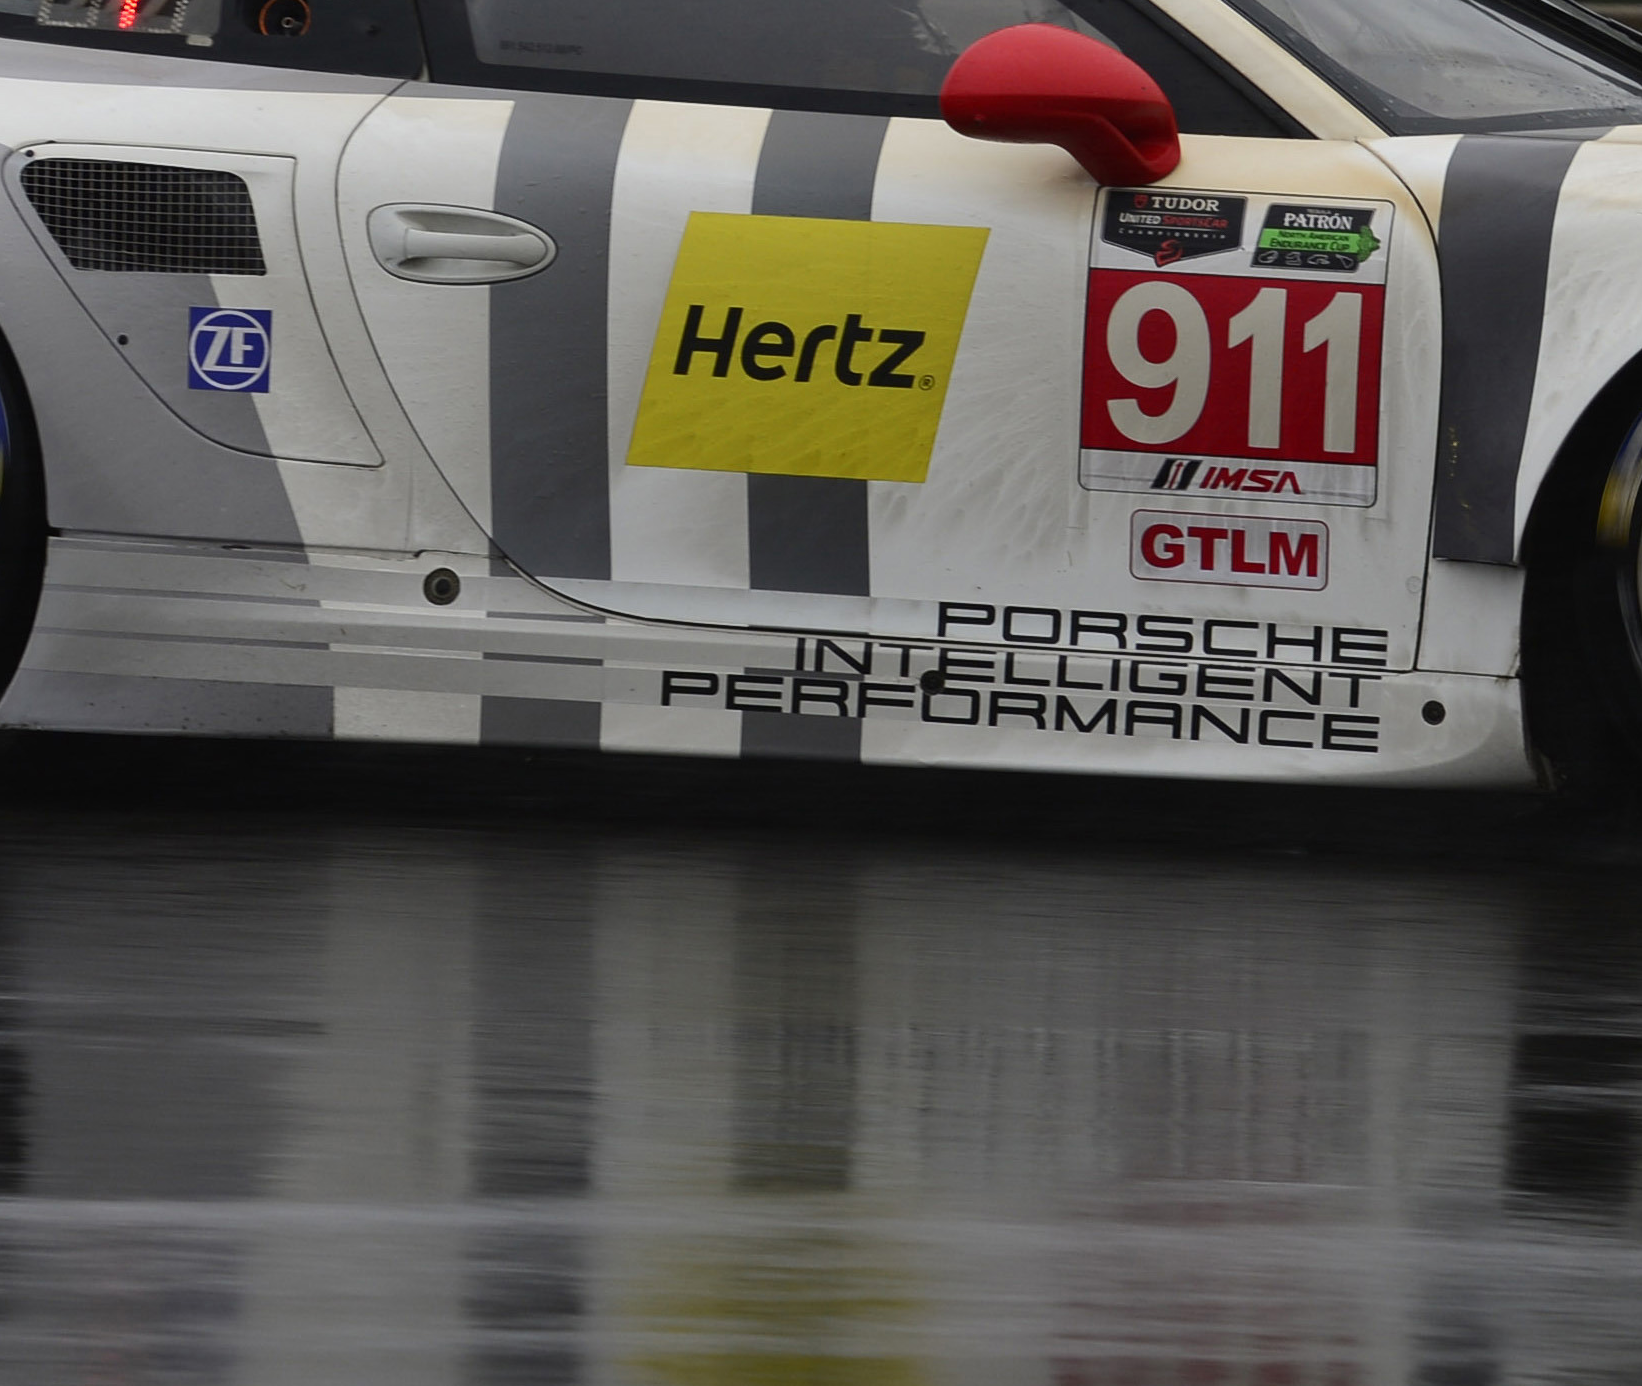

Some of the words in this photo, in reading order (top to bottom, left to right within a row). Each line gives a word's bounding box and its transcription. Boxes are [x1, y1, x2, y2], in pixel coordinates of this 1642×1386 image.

[1119, 213, 1162, 225] UNITED
[1151, 196, 1220, 212] TUDOR
[1283, 212, 1354, 230] PATRÓN
[673, 304, 926, 389] Hertz
[1106, 280, 1362, 454] 911
[1199, 466, 1303, 495] IMSA
[1140, 523, 1318, 578] GTLM
[937, 602, 1388, 667] PORSCHE
[795, 637, 1382, 708] INTELLIGENT
[661, 670, 1380, 753] PERFORMANCE
